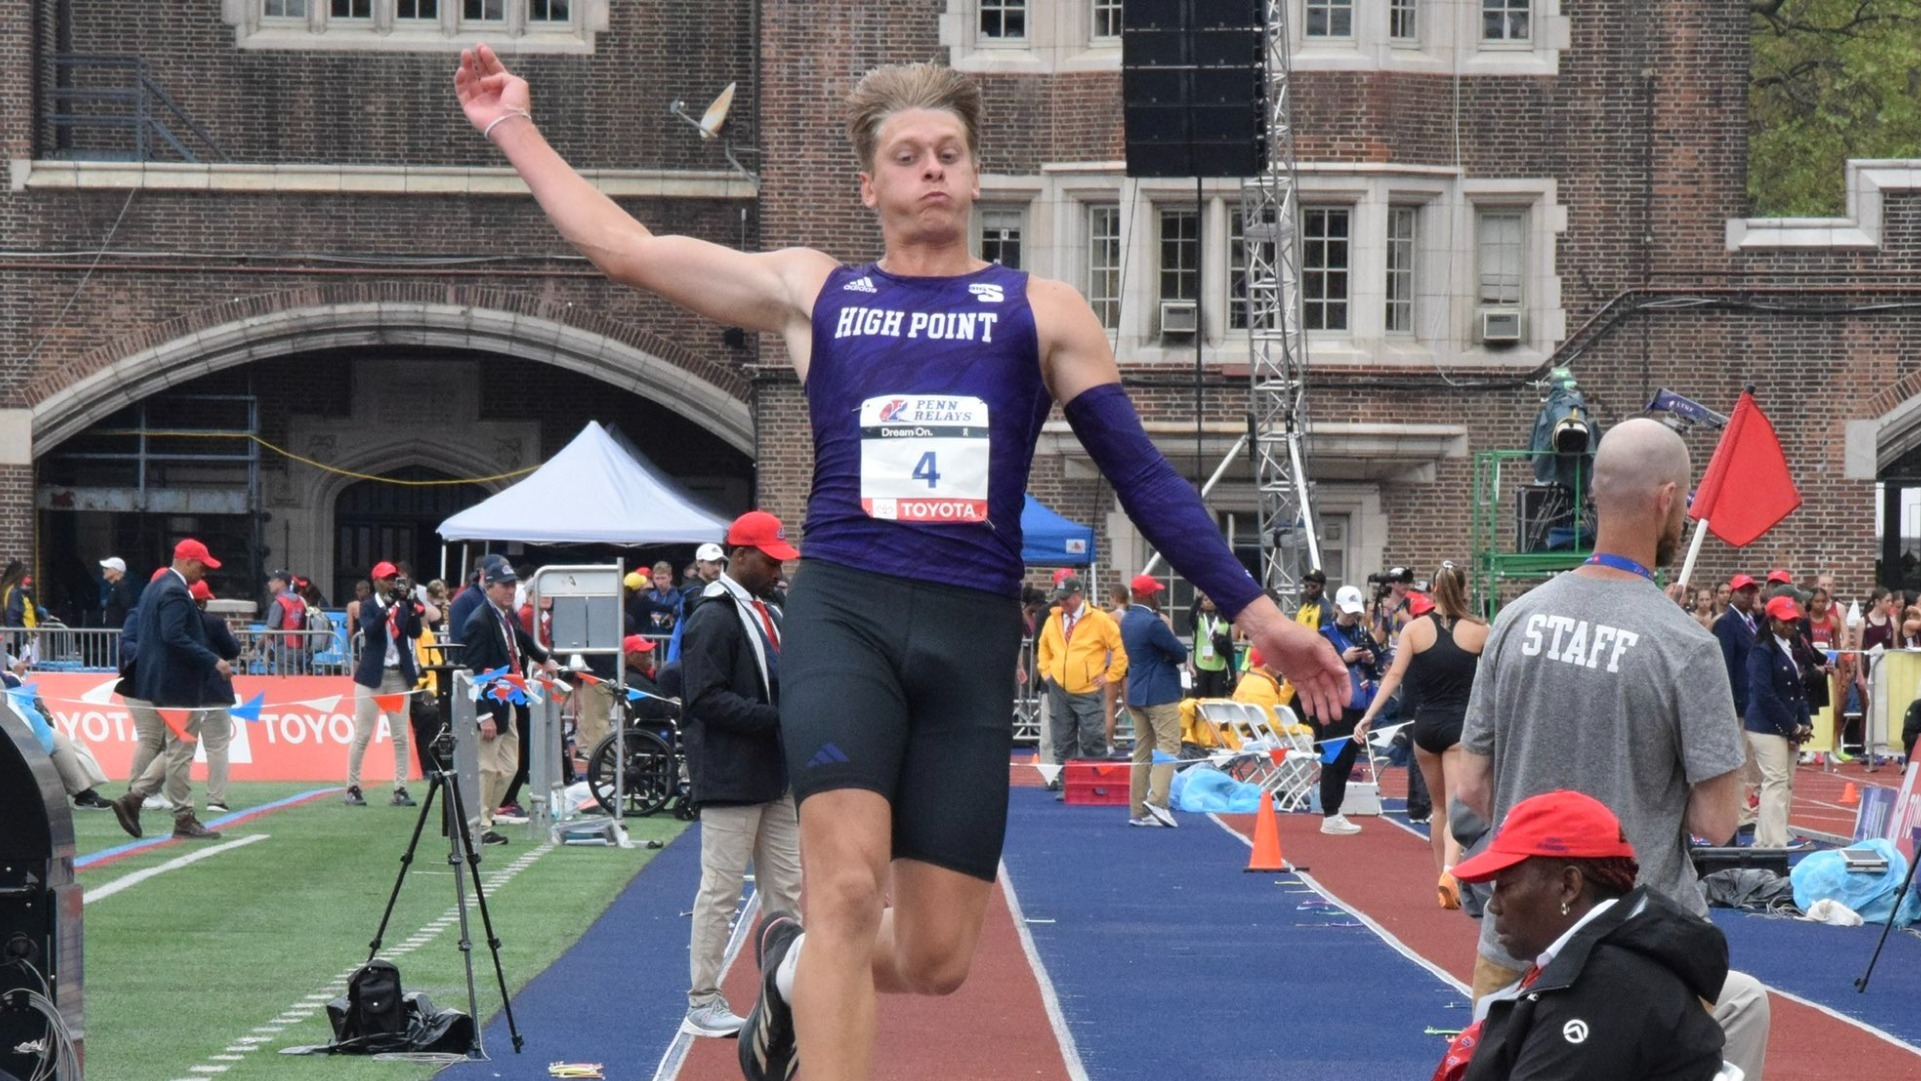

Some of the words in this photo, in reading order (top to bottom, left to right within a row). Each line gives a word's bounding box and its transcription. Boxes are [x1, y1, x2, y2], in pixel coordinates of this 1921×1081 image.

[843, 284, 878, 293] adidas
[834, 307, 905, 339] HIGH
[907, 312, 998, 343] POINT
[916, 400, 958, 410] PENN
[914, 411, 972, 421] RELAYS
[881, 428, 914, 437] Dream
[915, 427, 933, 436] On.
[912, 451, 941, 488] 4
[901, 503, 976, 518] TOYOTA
[1521, 613, 1640, 673] STAFF
[51, 711, 138, 742] YOT
[258, 713, 392, 744] TOYOA
